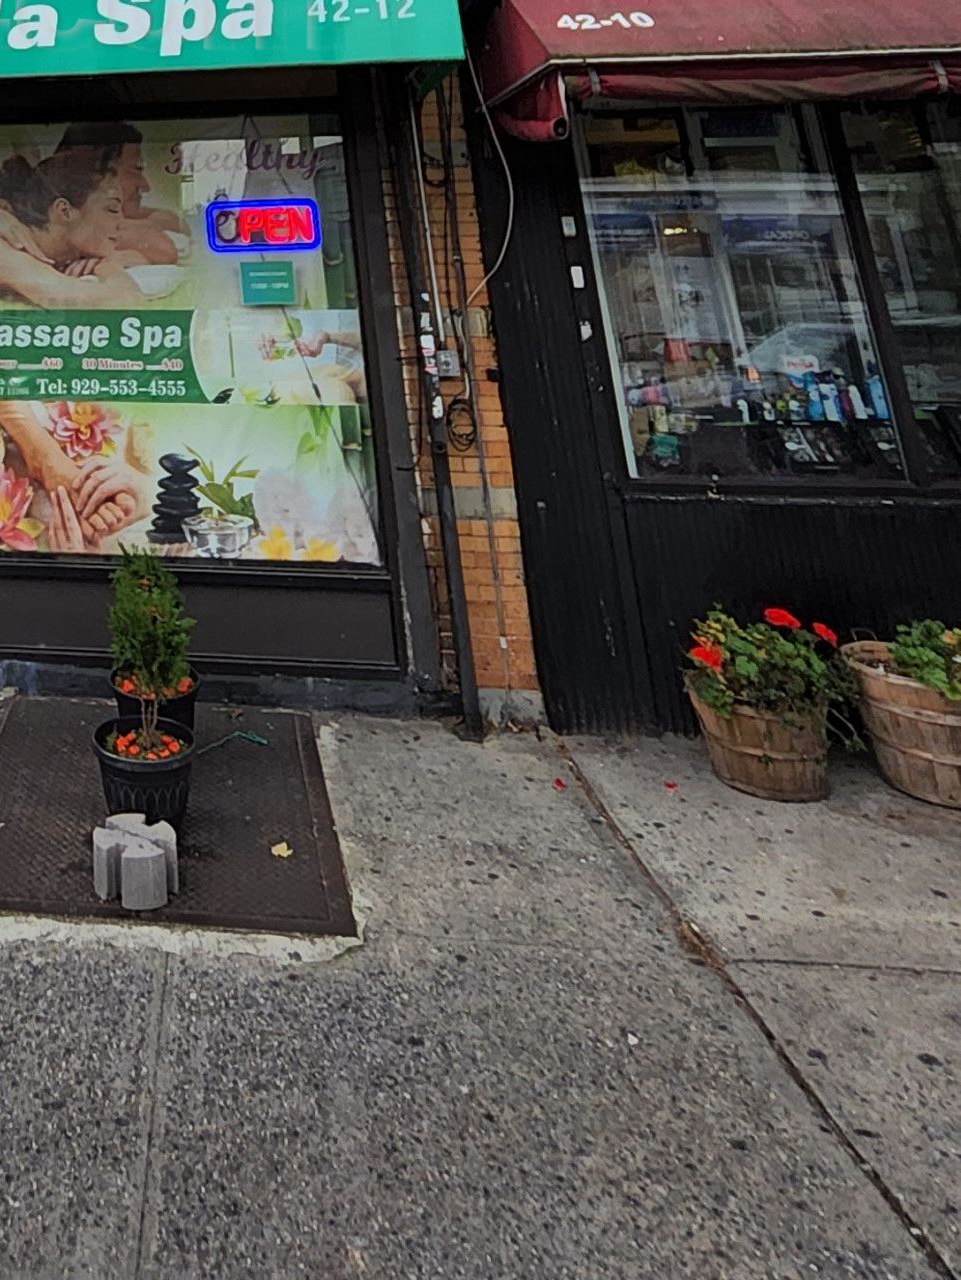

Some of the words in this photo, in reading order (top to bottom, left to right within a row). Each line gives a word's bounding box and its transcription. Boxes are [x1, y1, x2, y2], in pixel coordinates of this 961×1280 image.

[556, 11, 656, 31] 42-10
[120, 316, 183, 355] Spa
[98, 358, 143, 370] Minutes
[38, 378, 68, 396] Tel:
[71, 378, 186, 396] 929-553-4555
